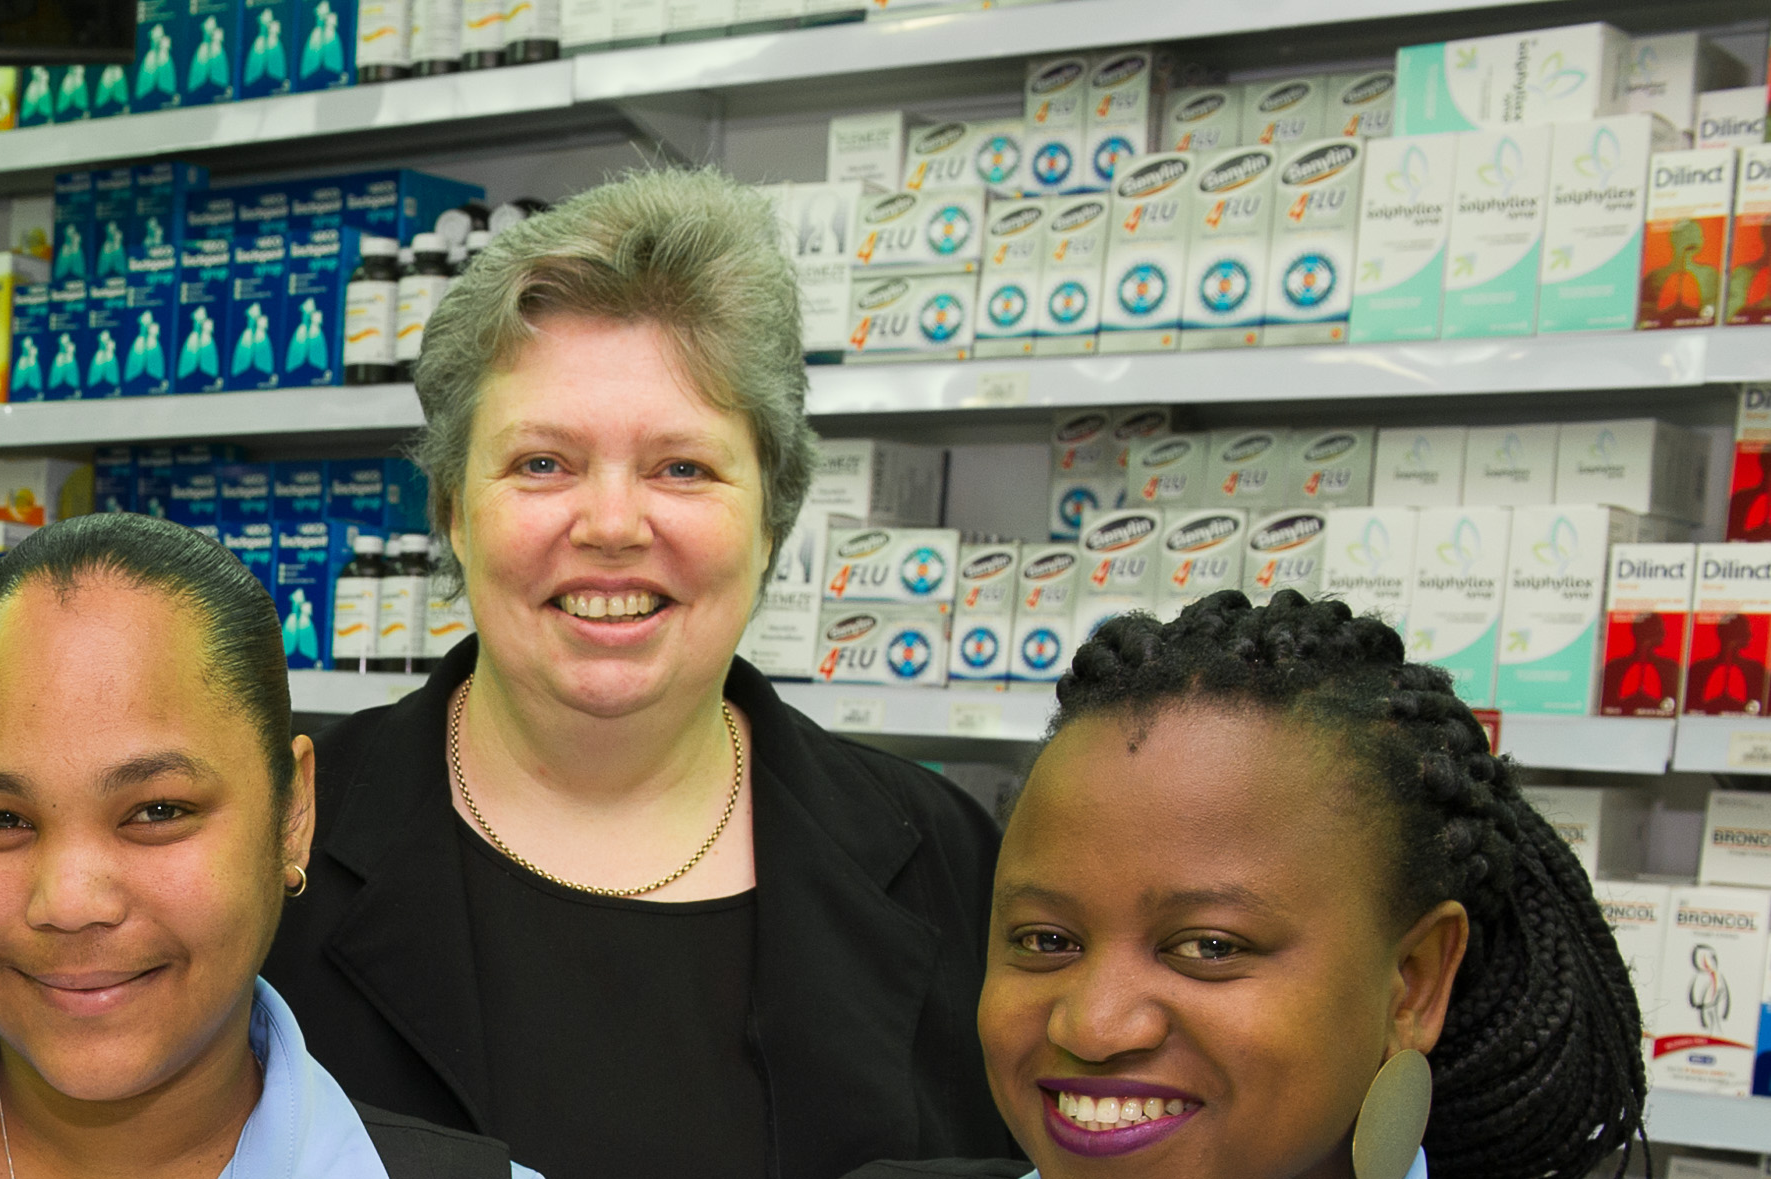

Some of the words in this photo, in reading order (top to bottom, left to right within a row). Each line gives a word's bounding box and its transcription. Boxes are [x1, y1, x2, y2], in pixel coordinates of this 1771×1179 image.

[1654, 164, 1725, 189] Dilinct
[1617, 559, 1687, 580] Dilinct
[1713, 829, 1771, 846] BRONC
[1601, 904, 1656, 922] ONCOL
[1677, 910, 1758, 931] BRONCOL
